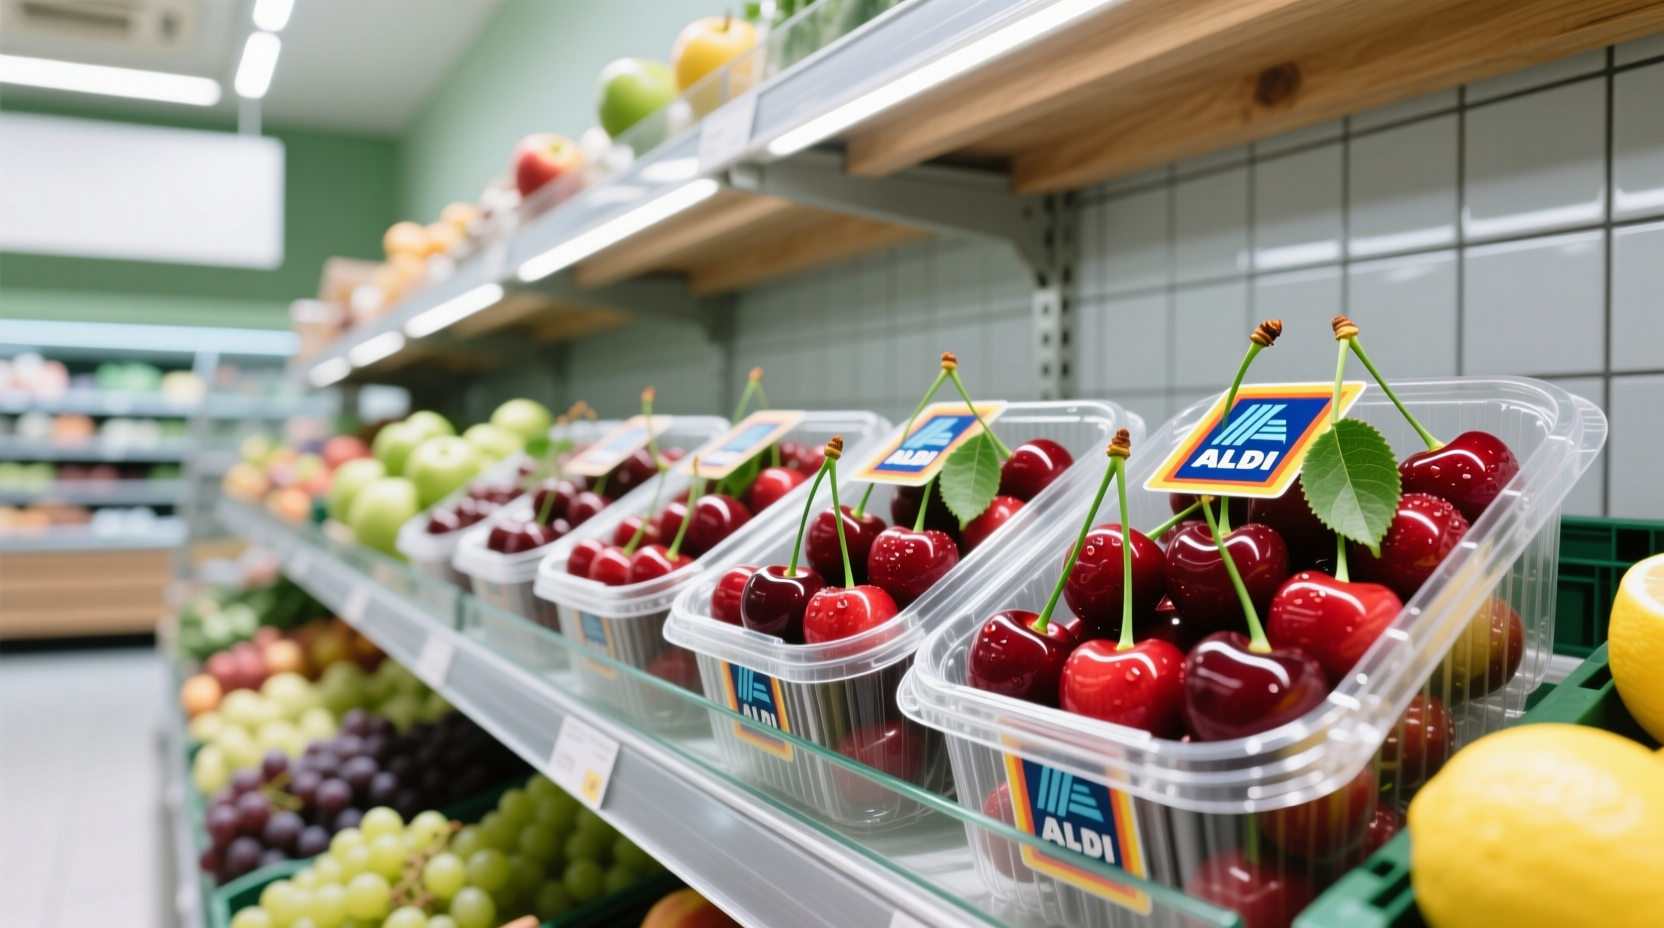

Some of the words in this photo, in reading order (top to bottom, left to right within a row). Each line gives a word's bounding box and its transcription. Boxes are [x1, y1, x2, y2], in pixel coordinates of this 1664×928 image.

[884, 449, 940, 466] ALDI
[1190, 449, 1280, 471] ALDI
[1042, 816, 1115, 864] ALDI
